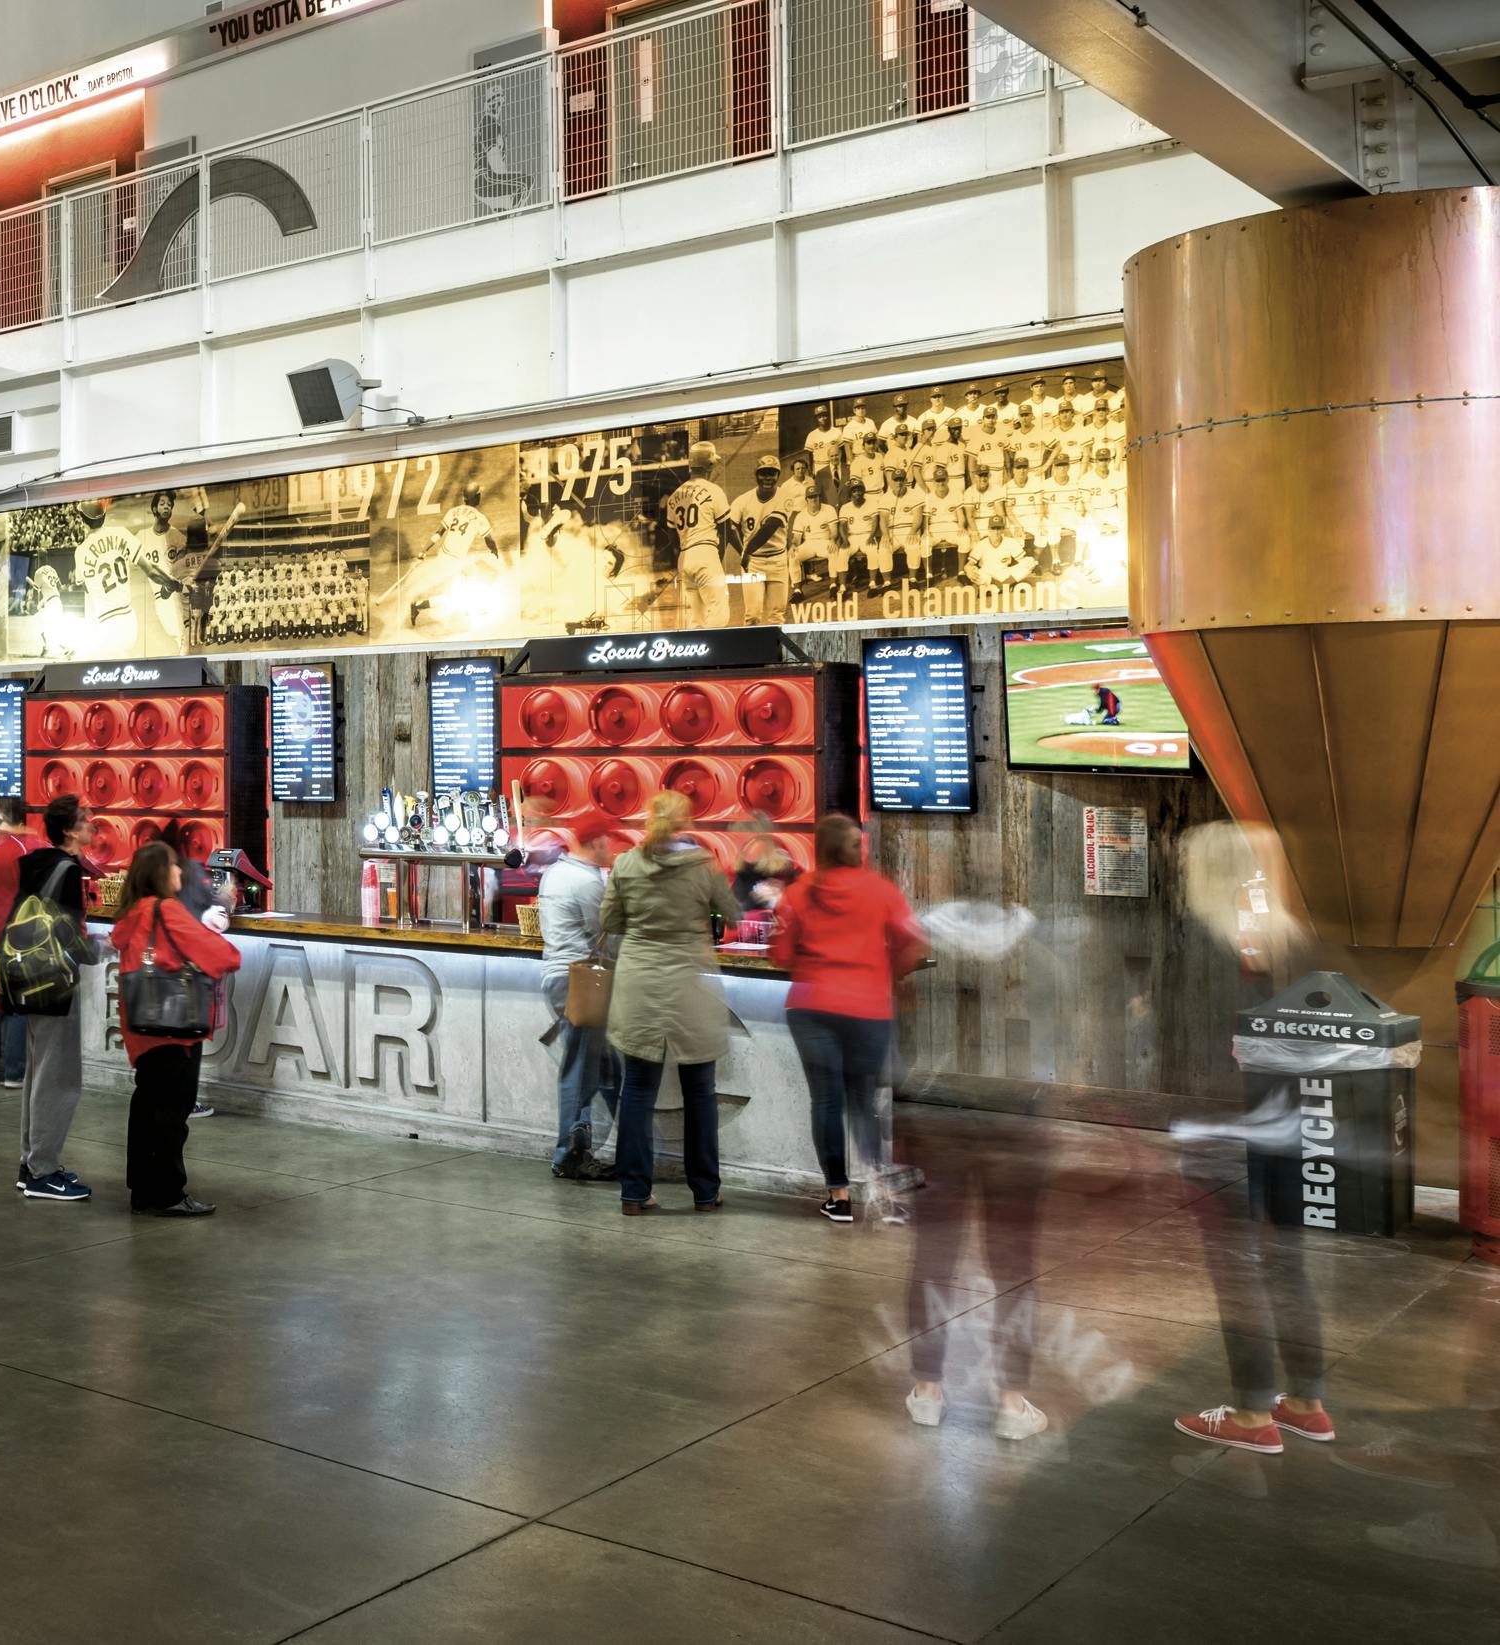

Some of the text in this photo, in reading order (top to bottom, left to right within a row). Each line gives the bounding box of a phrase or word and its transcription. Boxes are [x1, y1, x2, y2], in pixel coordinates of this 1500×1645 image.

[253, 0, 302, 35] GOTTA
[87, 66, 136, 93] DAVE BRISTOL
[539, 435, 632, 504] 1975
[325, 454, 442, 524] 1972
[449, 517, 469, 536] 24
[675, 503, 699, 531] 30
[746, 516, 755, 532] 8
[97, 556, 129, 594] 20
[791, 577, 1080, 623] world champions
[588, 638, 710, 664] Local Brews
[875, 644, 952, 659] Local Brews
[82, 664, 160, 685] Local Brews
[277, 668, 325, 681] Local Brews
[437, 664, 491, 676] Local Brews
[1086, 808, 1095, 839] POLICY
[1086, 841, 1096, 880] ALCOHOL
[1273, 1021, 1351, 1039] RECYCLE
[1300, 1077, 1338, 1230] RECYCLE
